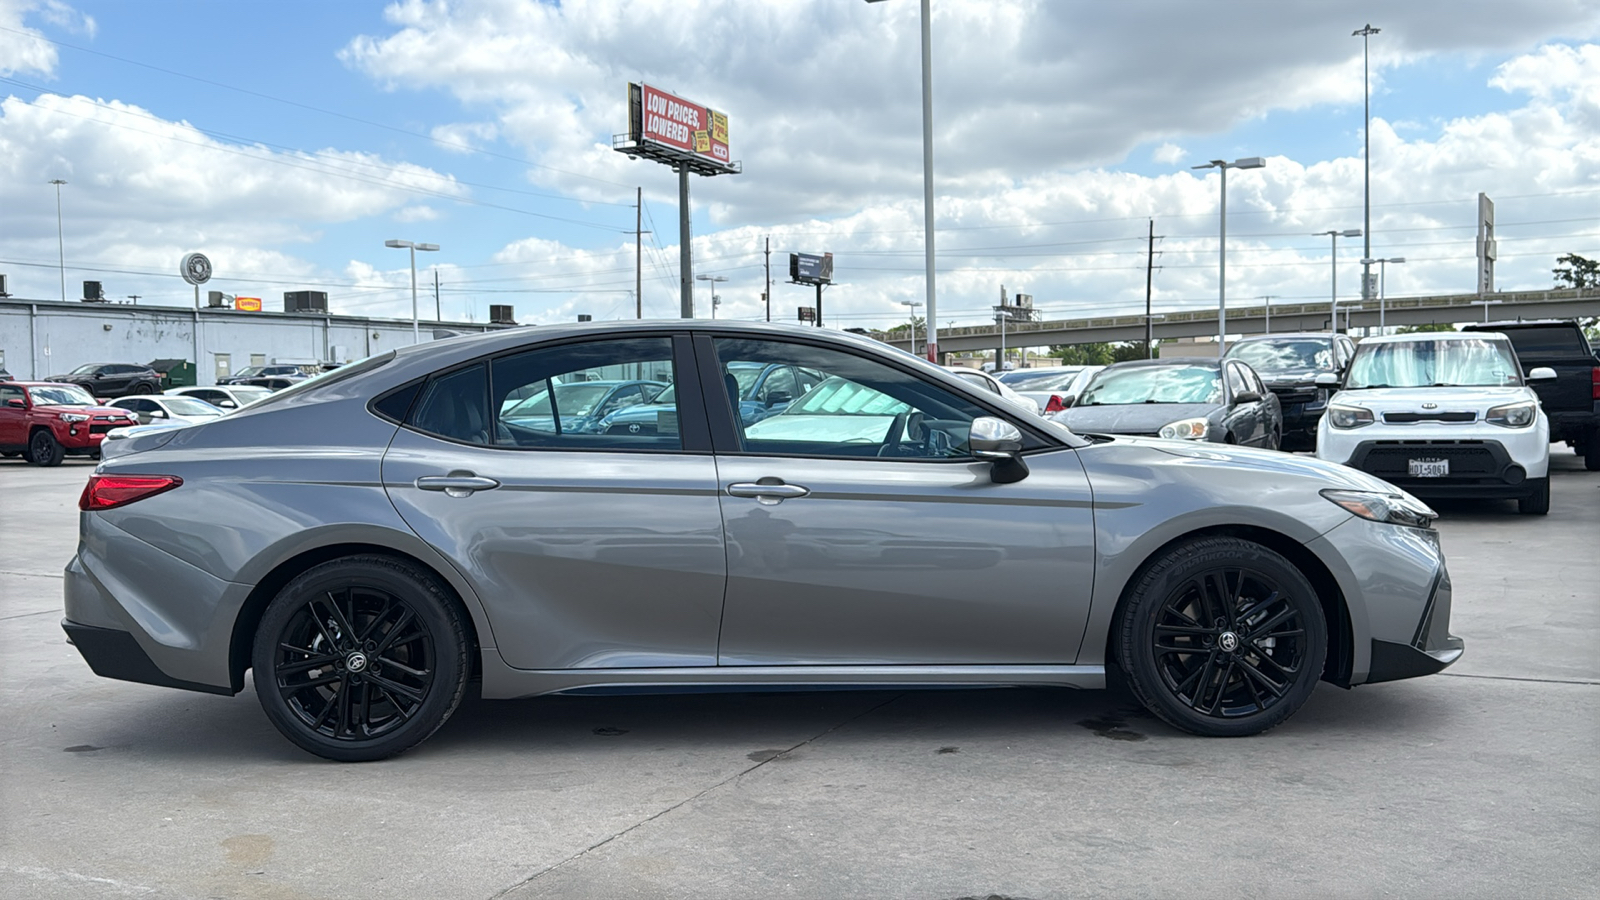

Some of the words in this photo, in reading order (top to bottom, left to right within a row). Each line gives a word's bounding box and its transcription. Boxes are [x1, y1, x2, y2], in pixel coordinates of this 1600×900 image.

[647, 92, 667, 116] LOW
[668, 100, 700, 130] PRICES,
[647, 113, 689, 144] LOWERED
